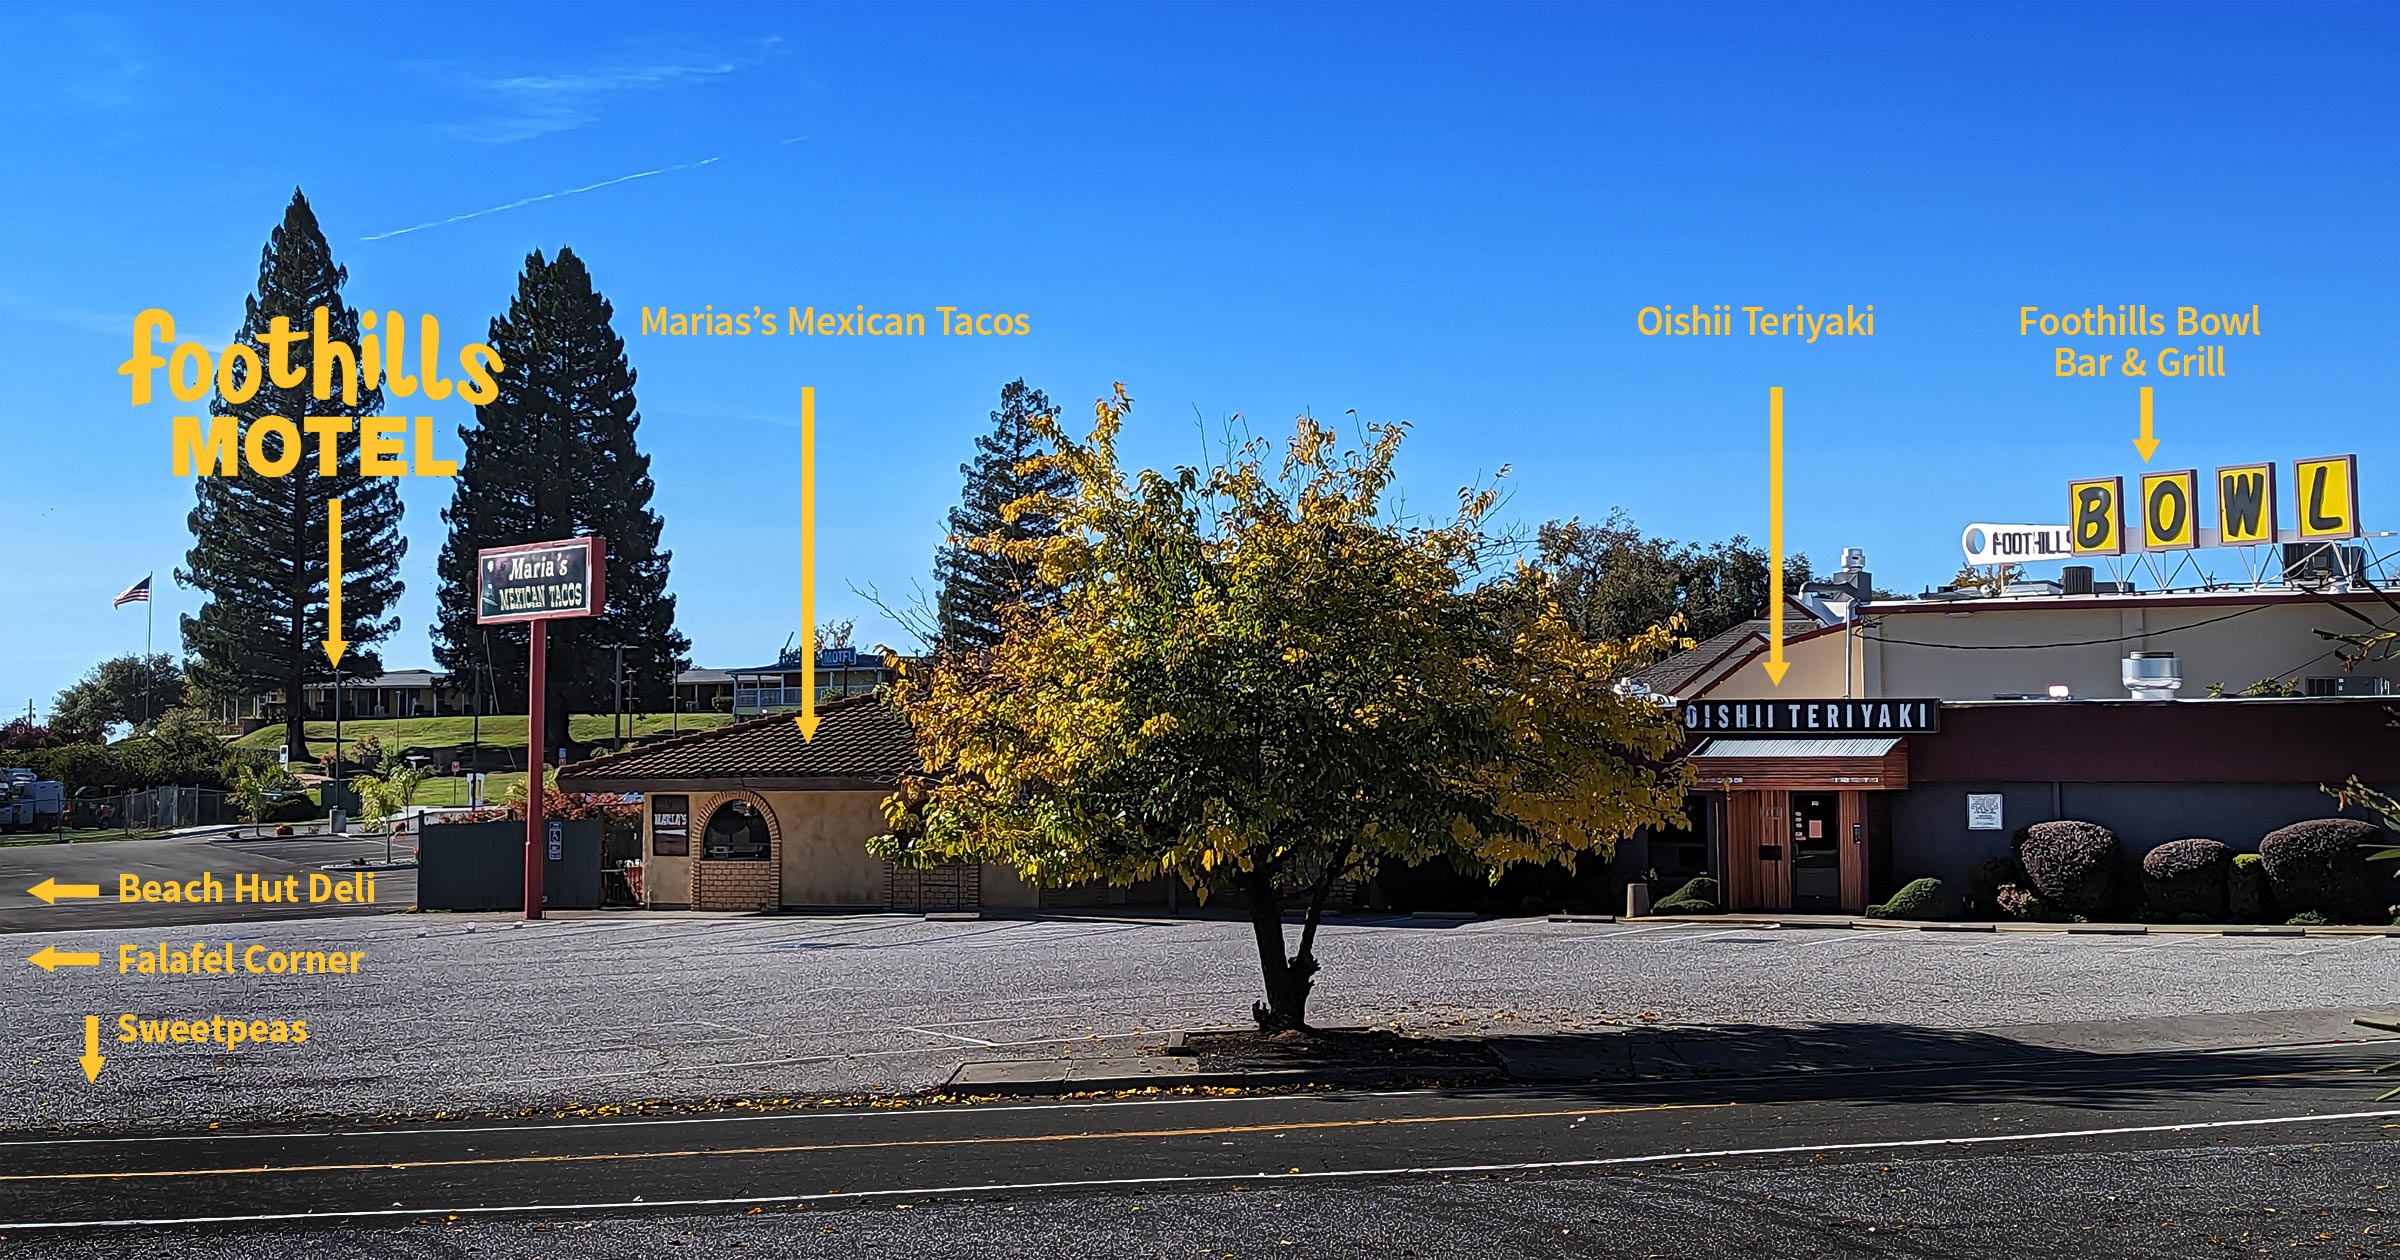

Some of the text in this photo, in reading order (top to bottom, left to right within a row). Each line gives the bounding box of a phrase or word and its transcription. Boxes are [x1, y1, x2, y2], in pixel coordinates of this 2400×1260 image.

[2077, 466, 2343, 549] BOWL
[509, 552, 568, 581] Maria's
[499, 583, 582, 611] MEXICAN TACOS
[1686, 703, 1926, 728] OISHII TERIYAKI
